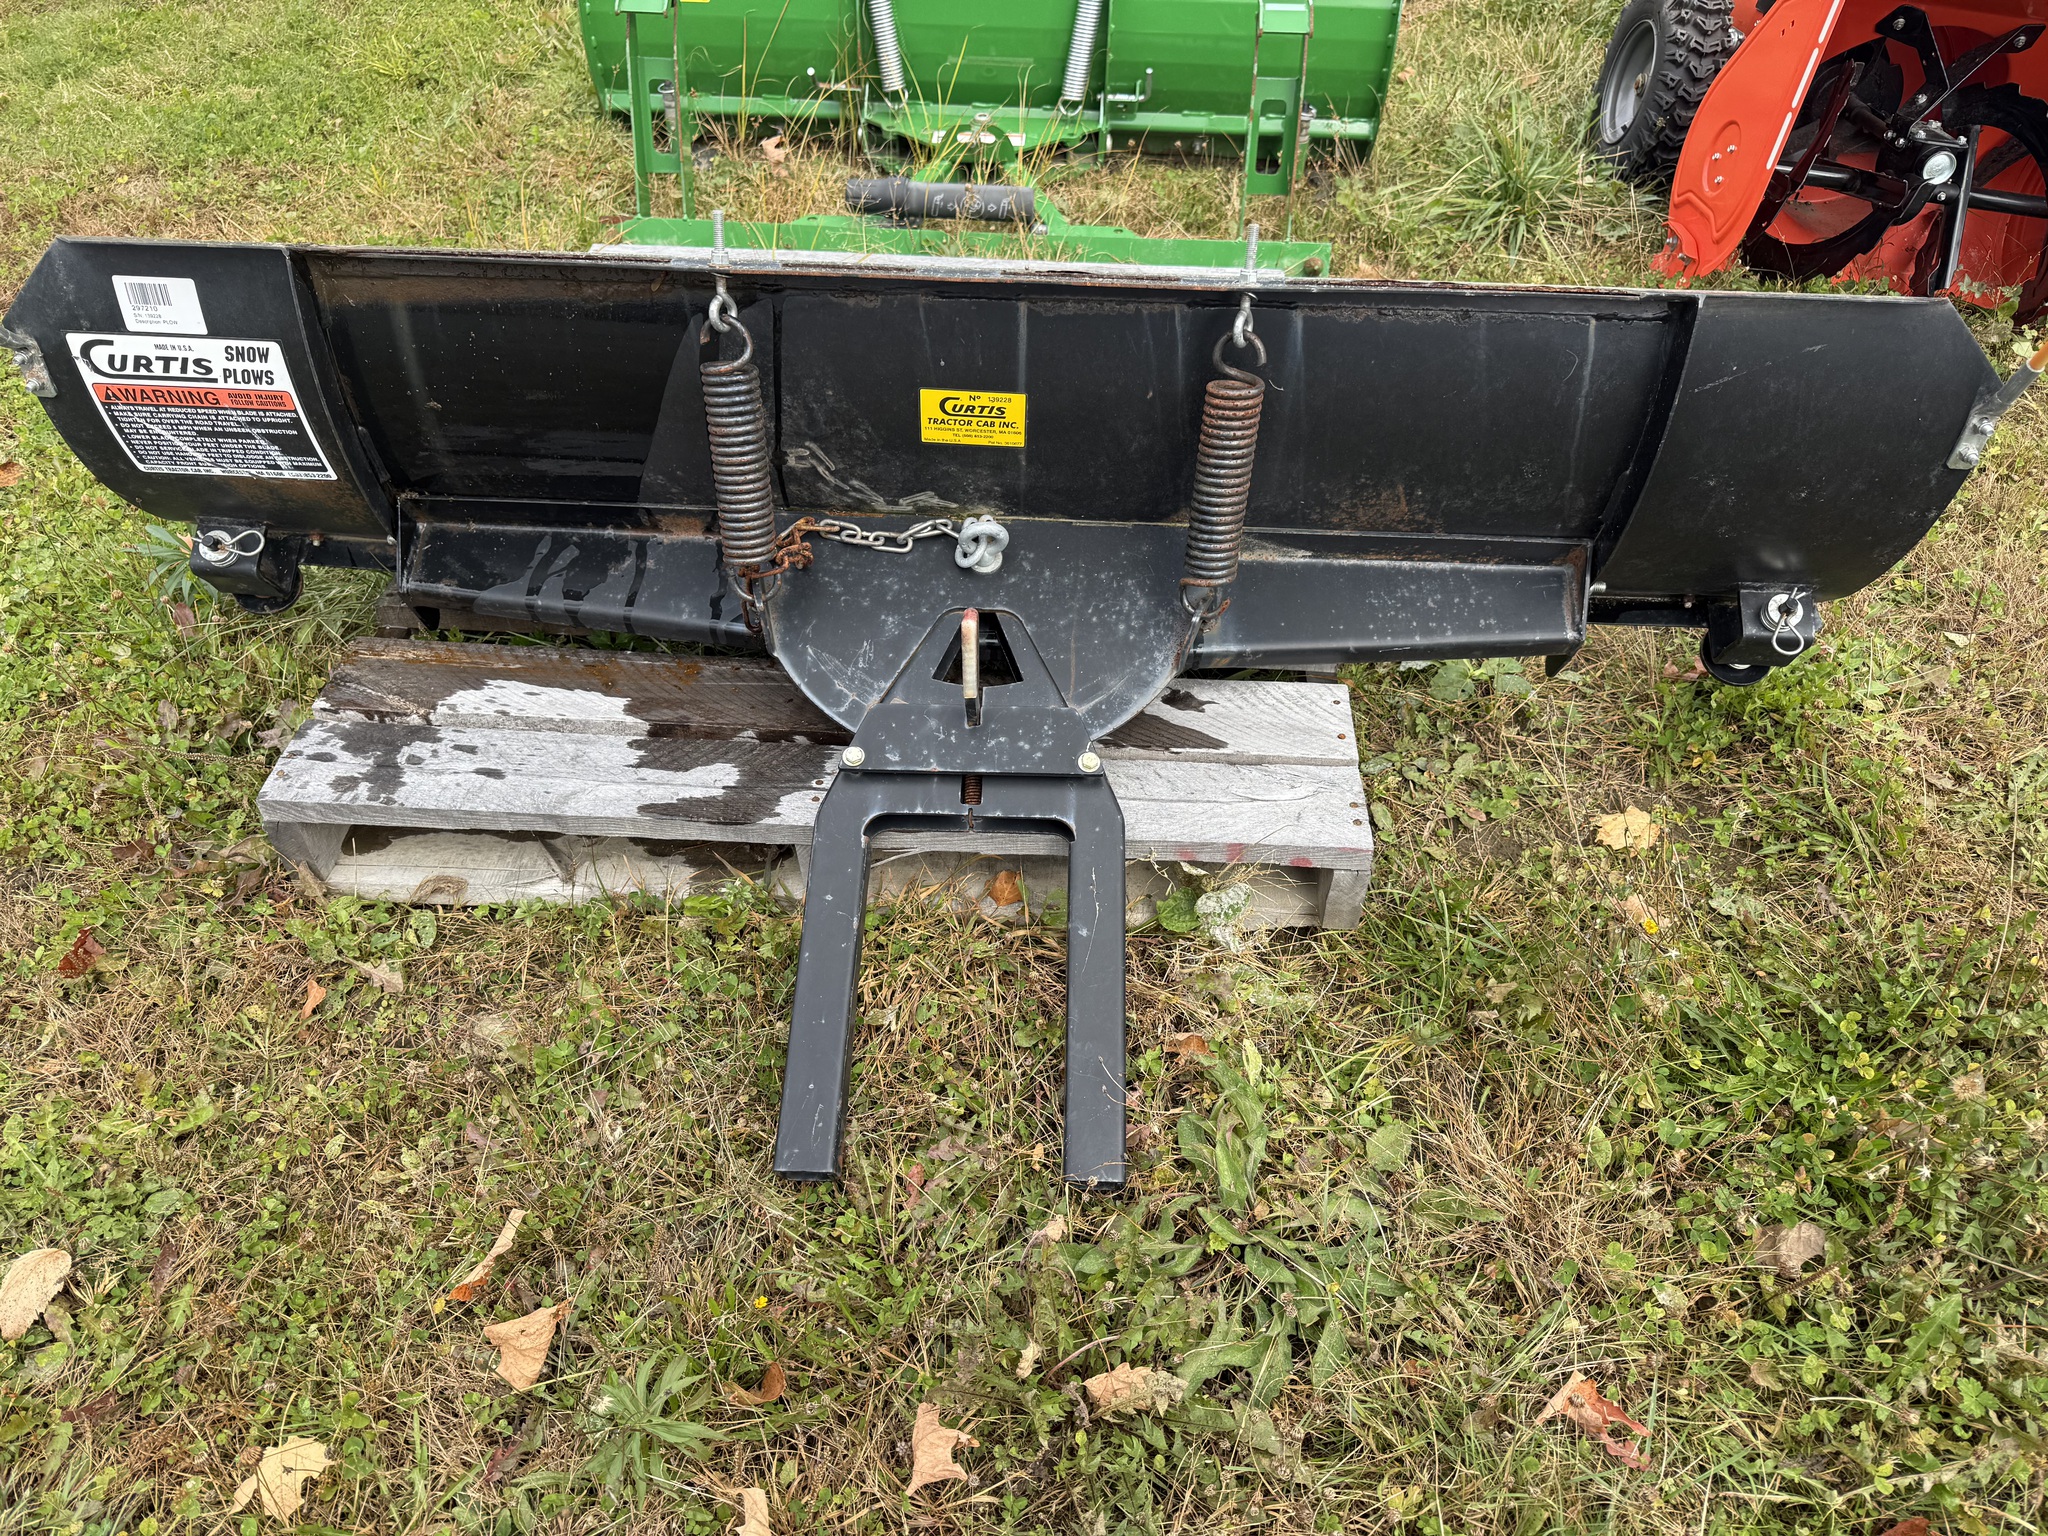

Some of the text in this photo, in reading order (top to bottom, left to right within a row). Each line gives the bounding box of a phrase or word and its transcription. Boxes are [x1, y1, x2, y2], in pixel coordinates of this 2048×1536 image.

[154, 343, 169, 351] MADE
[225, 345, 269, 363] SNOW
[80, 339, 218, 383] CURTIS
[223, 369, 275, 386] PLOWS
[117, 389, 221, 405] WARNING
[228, 393, 284, 402] AVOID INJURY
[230, 399, 287, 408] FOLLOW CAUTIONS
[939, 397, 1007, 419] CURTIS
[928, 418, 973, 426] TRACTOR
[999, 421, 1019, 429] INC.
